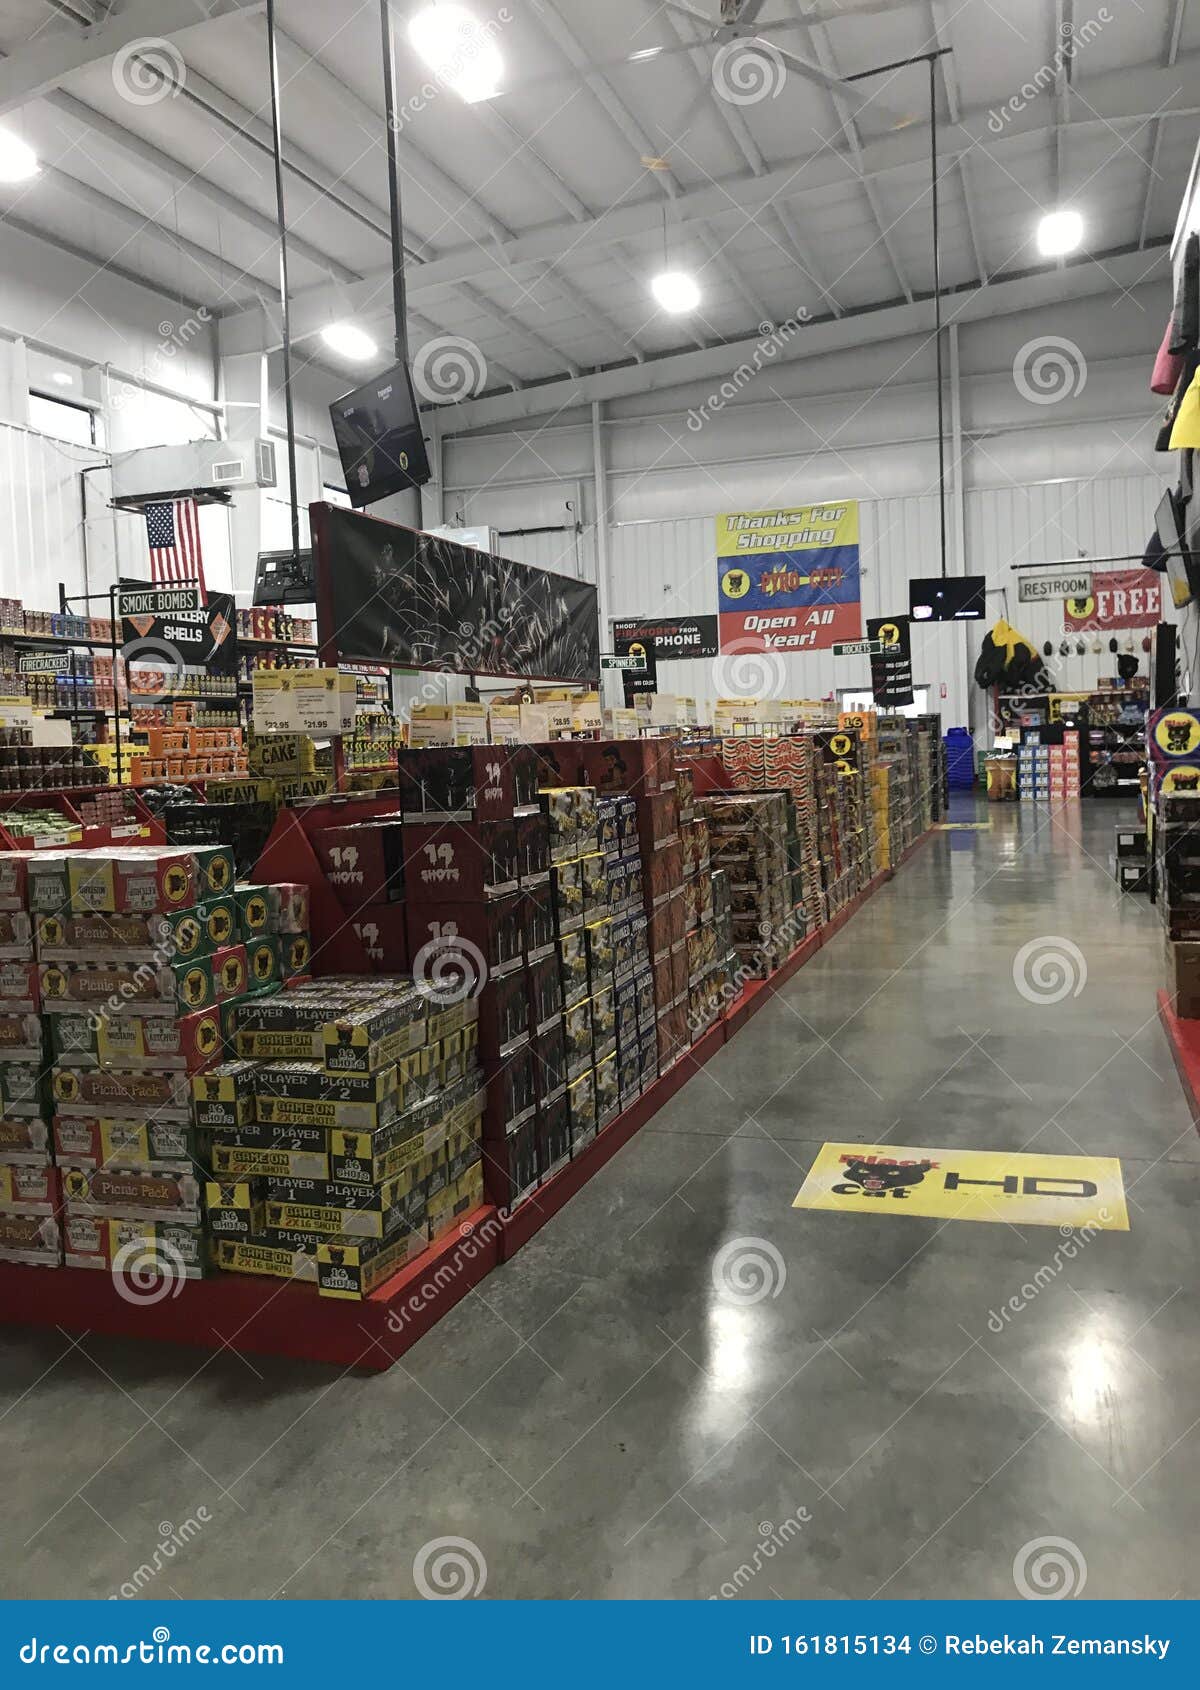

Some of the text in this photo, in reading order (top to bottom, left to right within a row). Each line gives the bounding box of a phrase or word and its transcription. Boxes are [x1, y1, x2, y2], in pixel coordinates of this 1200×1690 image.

[726, 506, 847, 531] Thanks For
[736, 528, 835, 550] Shopping
[760, 567, 844, 594] PYRO CITY
[1023, 578, 1088, 596] RESTROOM
[122, 592, 194, 613] SMOKE BOMBS
[1096, 588, 1160, 617] FREE
[155, 611, 210, 624] RTILLERY
[743, 610, 835, 632] Open All
[163, 625, 203, 642] SHELLS
[655, 634, 701, 646] PHONE
[763, 630, 816, 648] Year!
[842, 643, 872, 654] ROCKETS
[22, 657, 68, 671] FIRECRACKERS
[608, 658, 638, 668] SPINNERS
[264, 720, 290, 729] $22.95
[303, 719, 328, 729] $21.95
[341, 718, 352, 729] .95
[843, 716, 863, 728] 16
[261, 743, 297, 765] CAKE
[213, 784, 260, 802] HEAVY
[281, 779, 328, 801] HEAVY
[420, 868, 460, 883] SHOTS
[74, 926, 109, 939] Picnic
[79, 978, 114, 992] Picnic
[237, 1008, 341, 1020] PLAYER PLAYER
[256, 1034, 313, 1046] GAME ON
[260, 1073, 369, 1088] PLAYER PLAYER
[92, 1083, 161, 1097] Picnic Pack
[280, 1085, 350, 1099] 1 2
[277, 1103, 336, 1116] GAME ON
[306, 1115, 336, 1125] SHOTS
[272, 1127, 320, 1140] PLAYER
[291, 1139, 301, 1150] 2
[232, 1150, 289, 1165] GAME ON
[261, 1164, 290, 1175] SHOTS
[102, 1183, 169, 1199] Picnic Pack
[268, 1177, 375, 1198] PLAYER PLAYER
[832, 1183, 912, 1199] Cat
[943, 1172, 1098, 1198] HD
[287, 1189, 357, 1208] 1 2
[285, 1206, 341, 1221] GAME ON
[316, 1220, 342, 1231] SHOTS
[237, 1247, 293, 1264] GAME ON
[265, 1261, 293, 1274] SHOTS
[330, 1268, 348, 1280] 16
